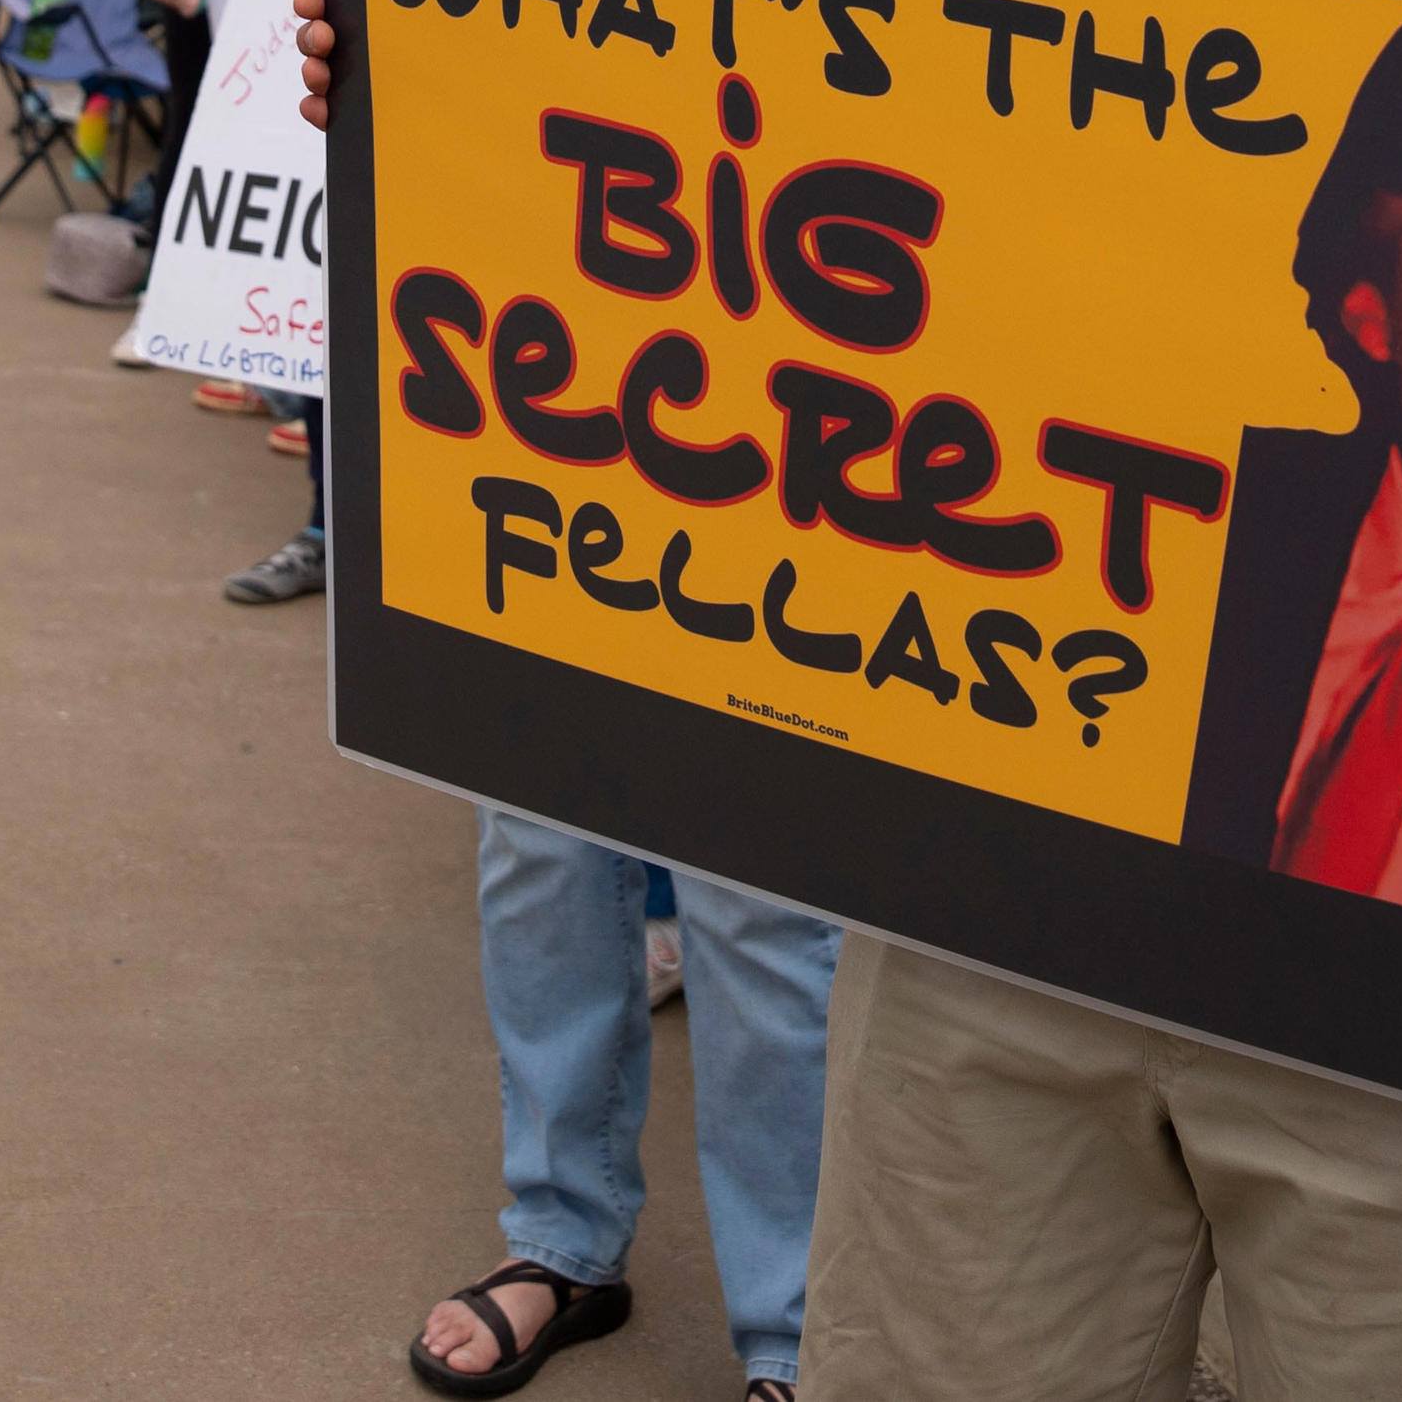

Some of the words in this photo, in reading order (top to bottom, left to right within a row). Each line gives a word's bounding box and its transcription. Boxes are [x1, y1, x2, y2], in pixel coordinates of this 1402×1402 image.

[240, 287, 323, 345] Safe
[149, 335, 189, 362] Our
[727, 694, 849, 741] BriteBlueDot.com
